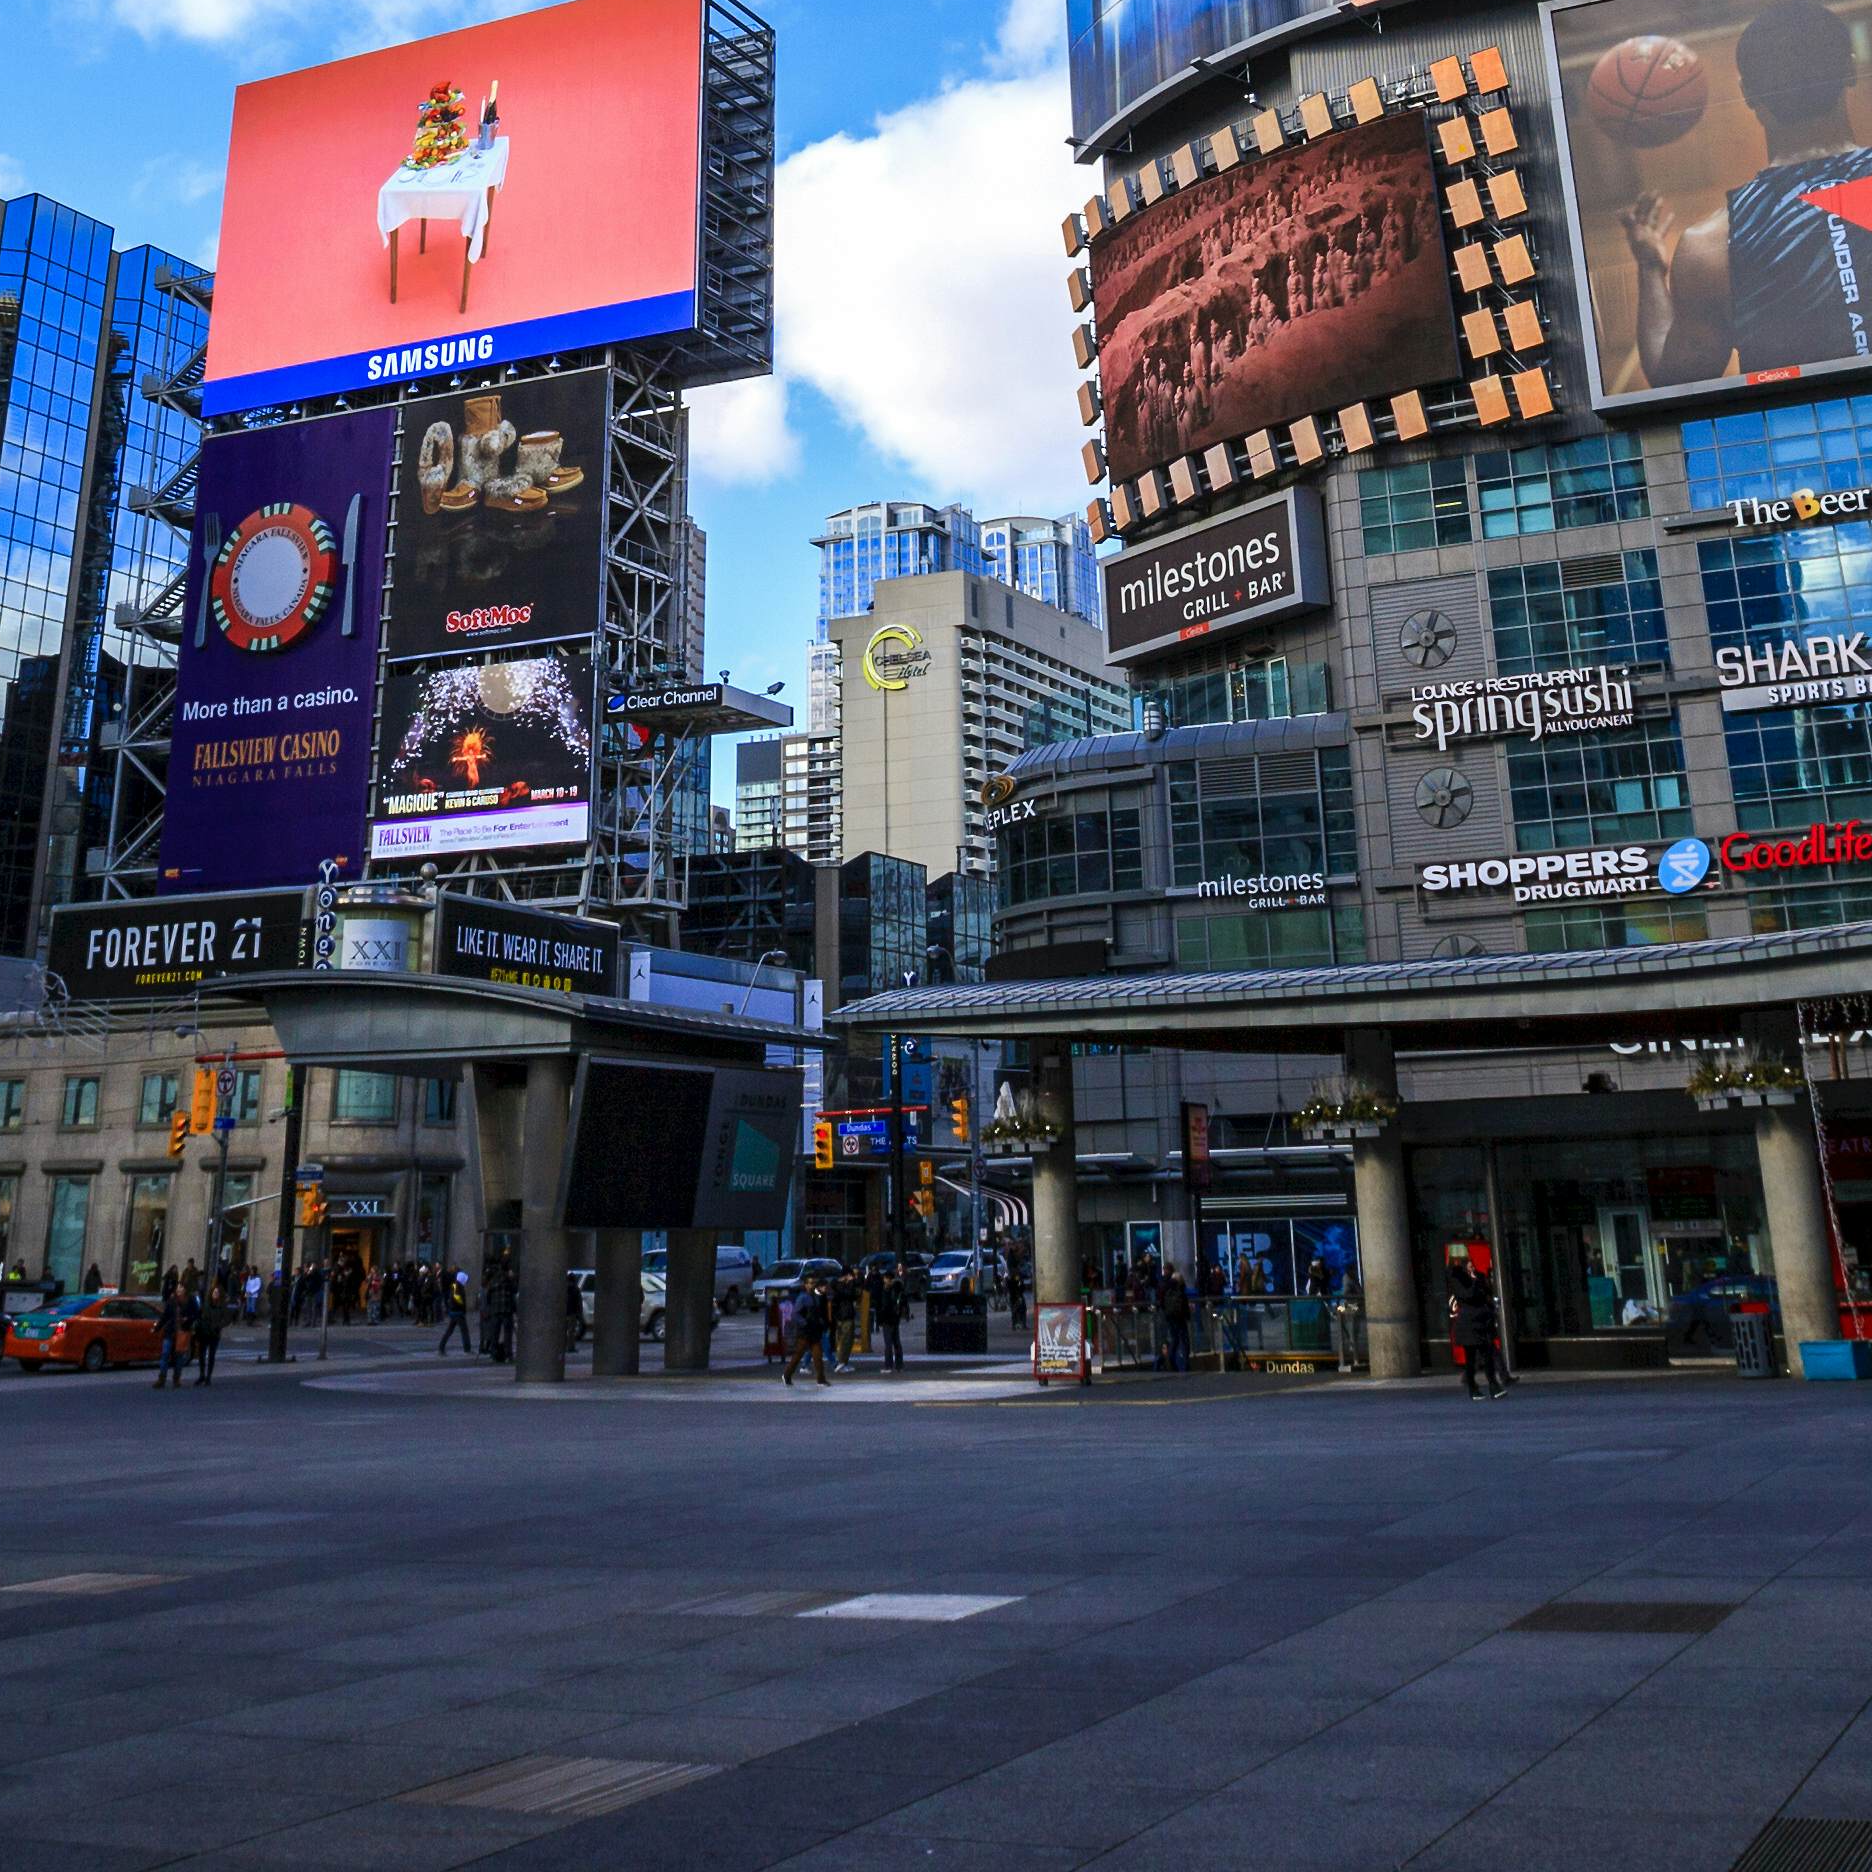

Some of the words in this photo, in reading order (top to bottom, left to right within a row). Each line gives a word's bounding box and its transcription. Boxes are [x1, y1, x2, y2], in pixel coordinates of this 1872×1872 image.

[1828, 212, 1860, 305] UNDER
[367, 334, 494, 381] SAMSUNG
[1756, 368, 1792, 383] Cieslok
[1727, 494, 1790, 528] The
[1120, 530, 1281, 614] milestones
[445, 604, 531, 632] SoftMoc
[1183, 591, 1230, 620] GRILL
[874, 650, 932, 667] CHELSEA
[1716, 630, 1872, 687] SHARK
[627, 695, 661, 709] Clear
[663, 686, 717, 705] Channel
[1411, 677, 1476, 703] LOUNGE
[1485, 666, 1592, 694] RESTAURANT
[1767, 677, 1845, 705] SPORTS
[183, 701, 227, 721] More
[233, 696, 272, 716] than
[277, 695, 288, 711] a
[293, 686, 359, 709] casino.
[193, 735, 278, 771] FALLSVIEW
[280, 728, 341, 761] CASINO
[192, 768, 277, 788] NIAGARA
[284, 760, 338, 780] FALLS
[531, 787, 555, 801] MARCH
[556, 785, 565, 799] 10
[570, 784, 578, 797] 19
[378, 825, 432, 847] FALLSVIEW
[493, 823, 508, 833] For
[1422, 846, 1651, 891] SHOPPERS
[1198, 872, 1324, 898] milestones
[1513, 879, 1582, 904] DRUG
[1584, 874, 1652, 897] MART
[1248, 897, 1286, 909] GRILL
[1299, 893, 1326, 906] BAR
[86, 921, 216, 970] FOREVER
[231, 917, 263, 960] 21
[297, 927, 309, 968] TOWN
[351, 940, 402, 960] XXI
[457, 925, 483, 957] LIKE
[487, 931, 499, 958] IT.
[503, 933, 536, 964] WEAR
[540, 938, 550, 966] IT.
[554, 941, 590, 972] SHARE
[592, 948, 603, 974] IT.
[732, 1174, 777, 1189] SQUARE
[347, 1200, 379, 1215] XXI
[1264, 1360, 1316, 1375] Dundas
